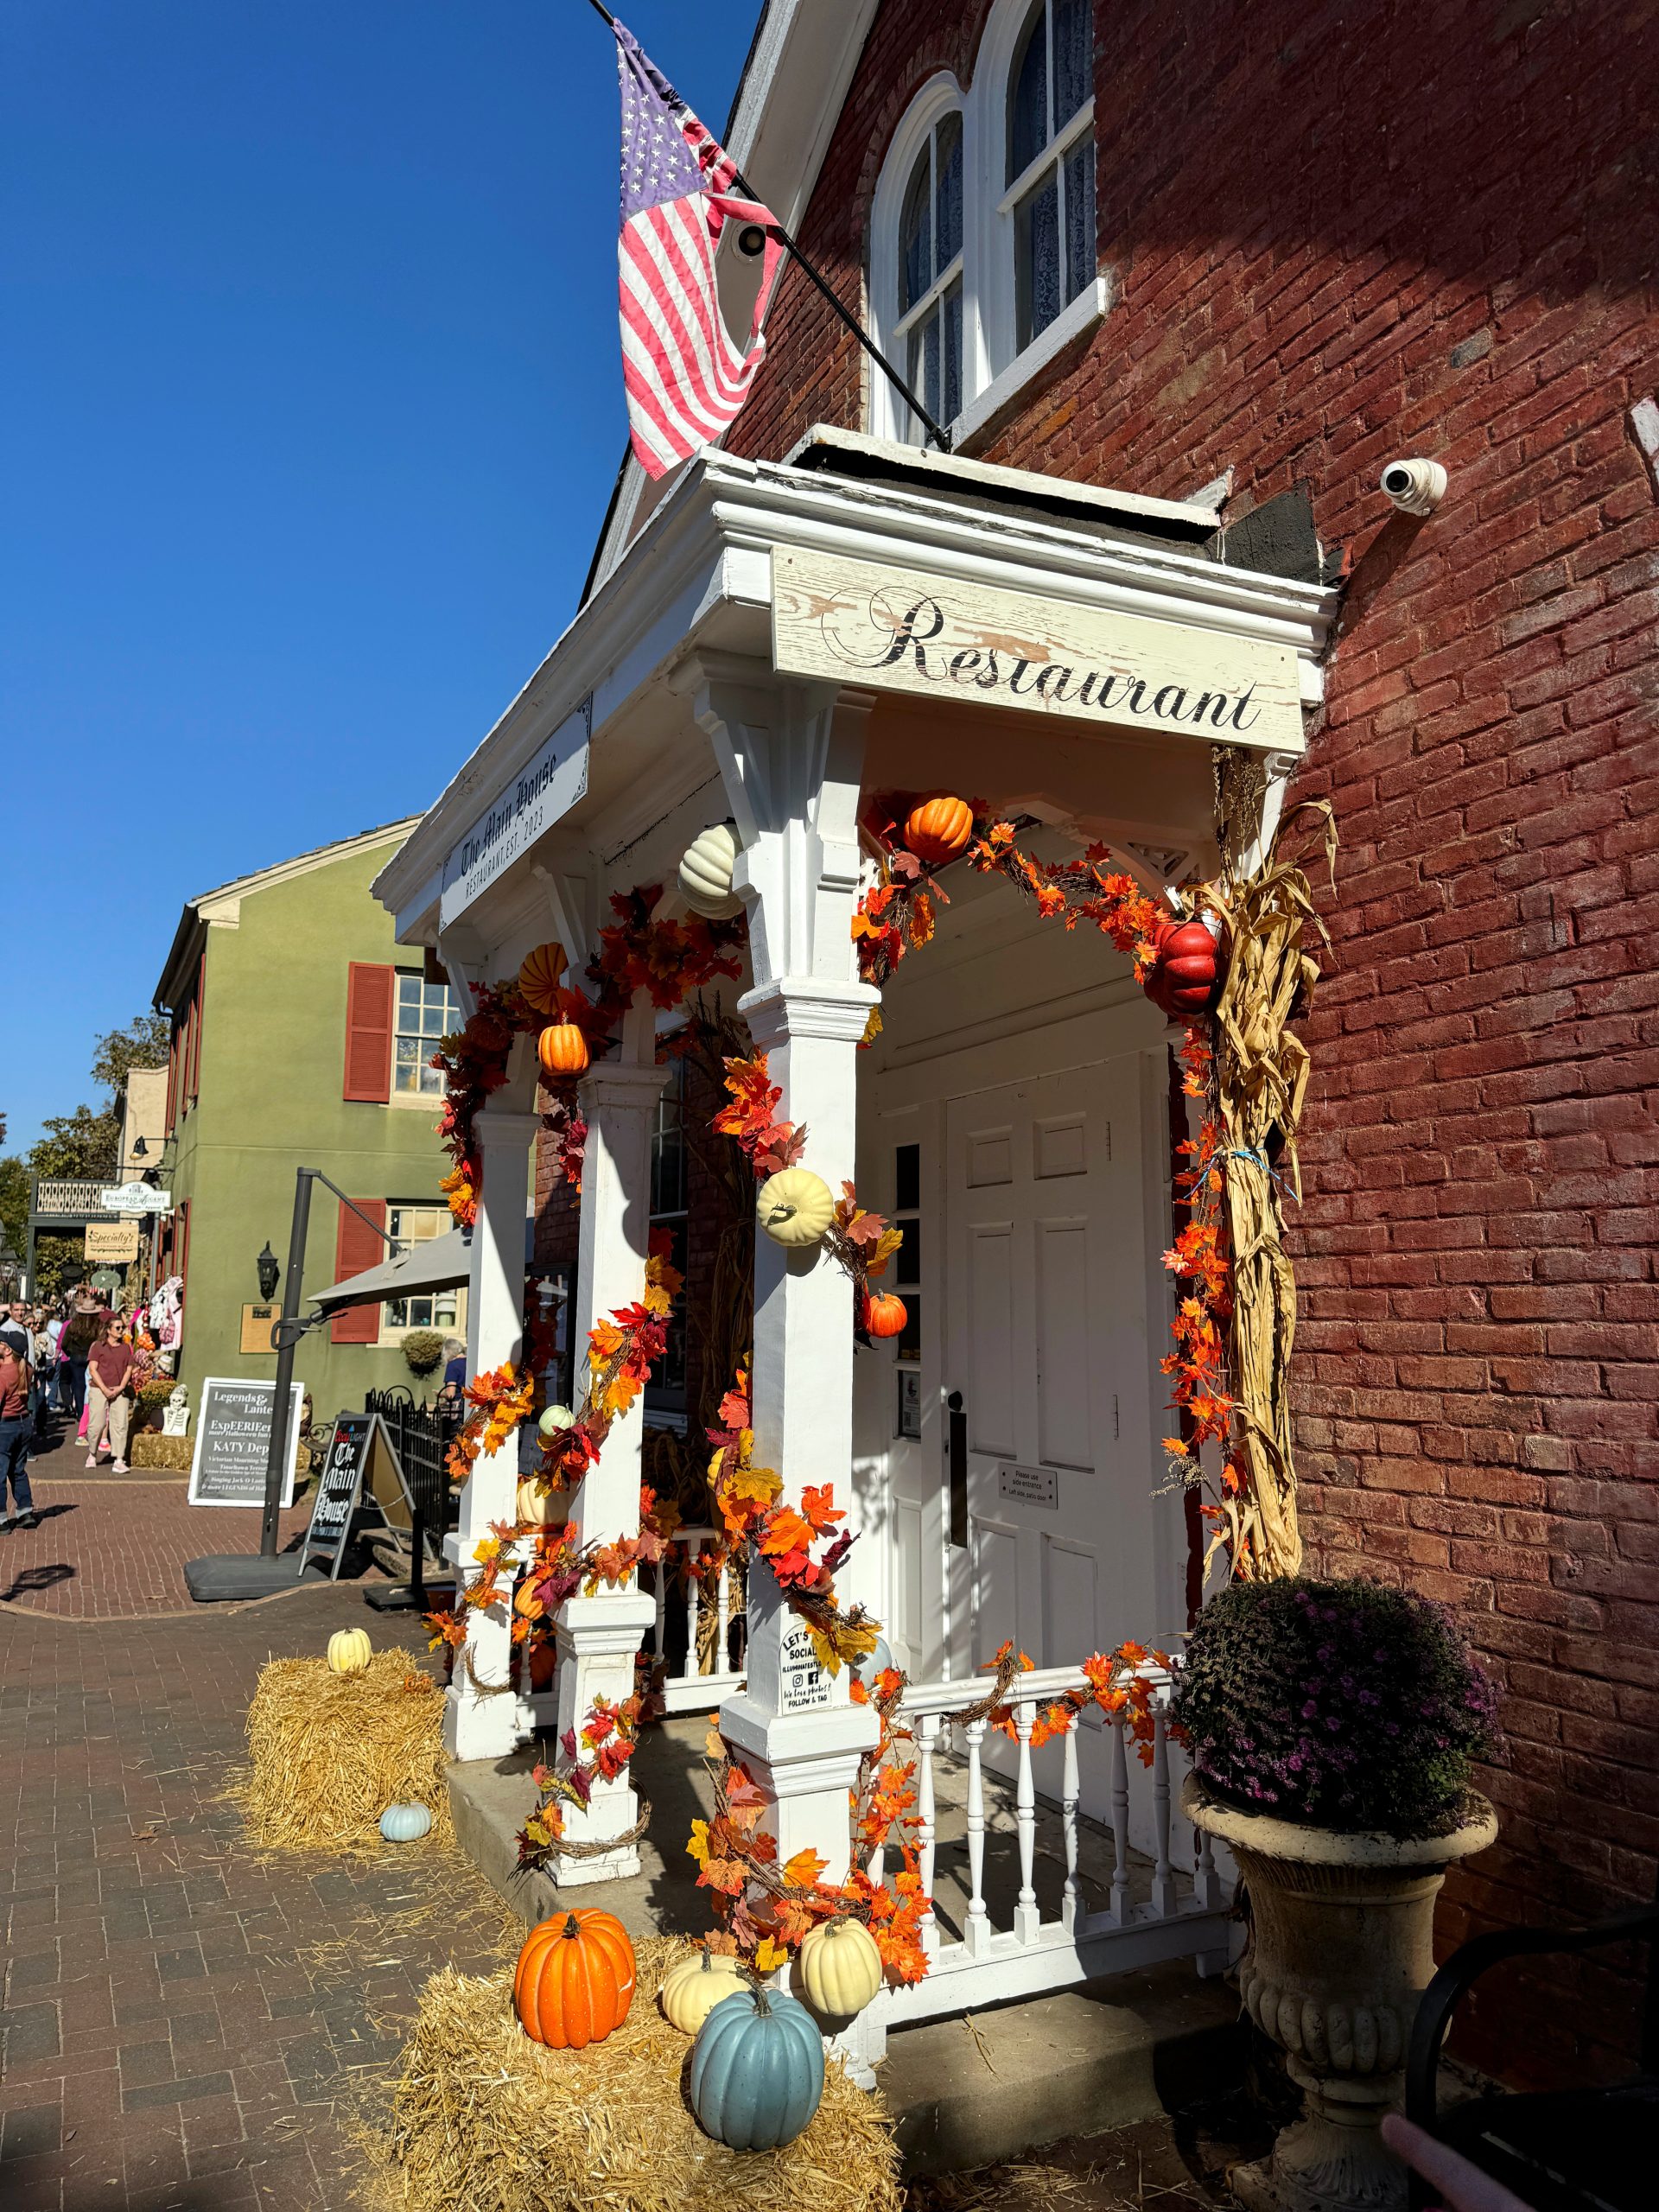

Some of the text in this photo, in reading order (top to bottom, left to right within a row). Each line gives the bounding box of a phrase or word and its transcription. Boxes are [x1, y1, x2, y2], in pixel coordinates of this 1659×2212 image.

[821, 586, 1262, 731] Restaurant
[461, 753, 557, 877] The Main House
[524, 805, 543, 842] 2023
[92, 1231, 134, 1244] Specialty's
[214, 1391, 256, 1403] Legends
[245, 1404, 274, 1414] Lante
[213, 1440, 270, 1456] KATY Dep
[334, 1442, 355, 1466] The
[323, 1464, 355, 1492] Main
[1015, 1470, 1029, 1478] Please
[1022, 1481, 1042, 1490] entrance
[314, 1493, 349, 1526] House
[783, 1630, 809, 1651] LET'S
[790, 1646, 817, 1660] SOCIAL
[788, 1697, 810, 1708] FOLLOW
